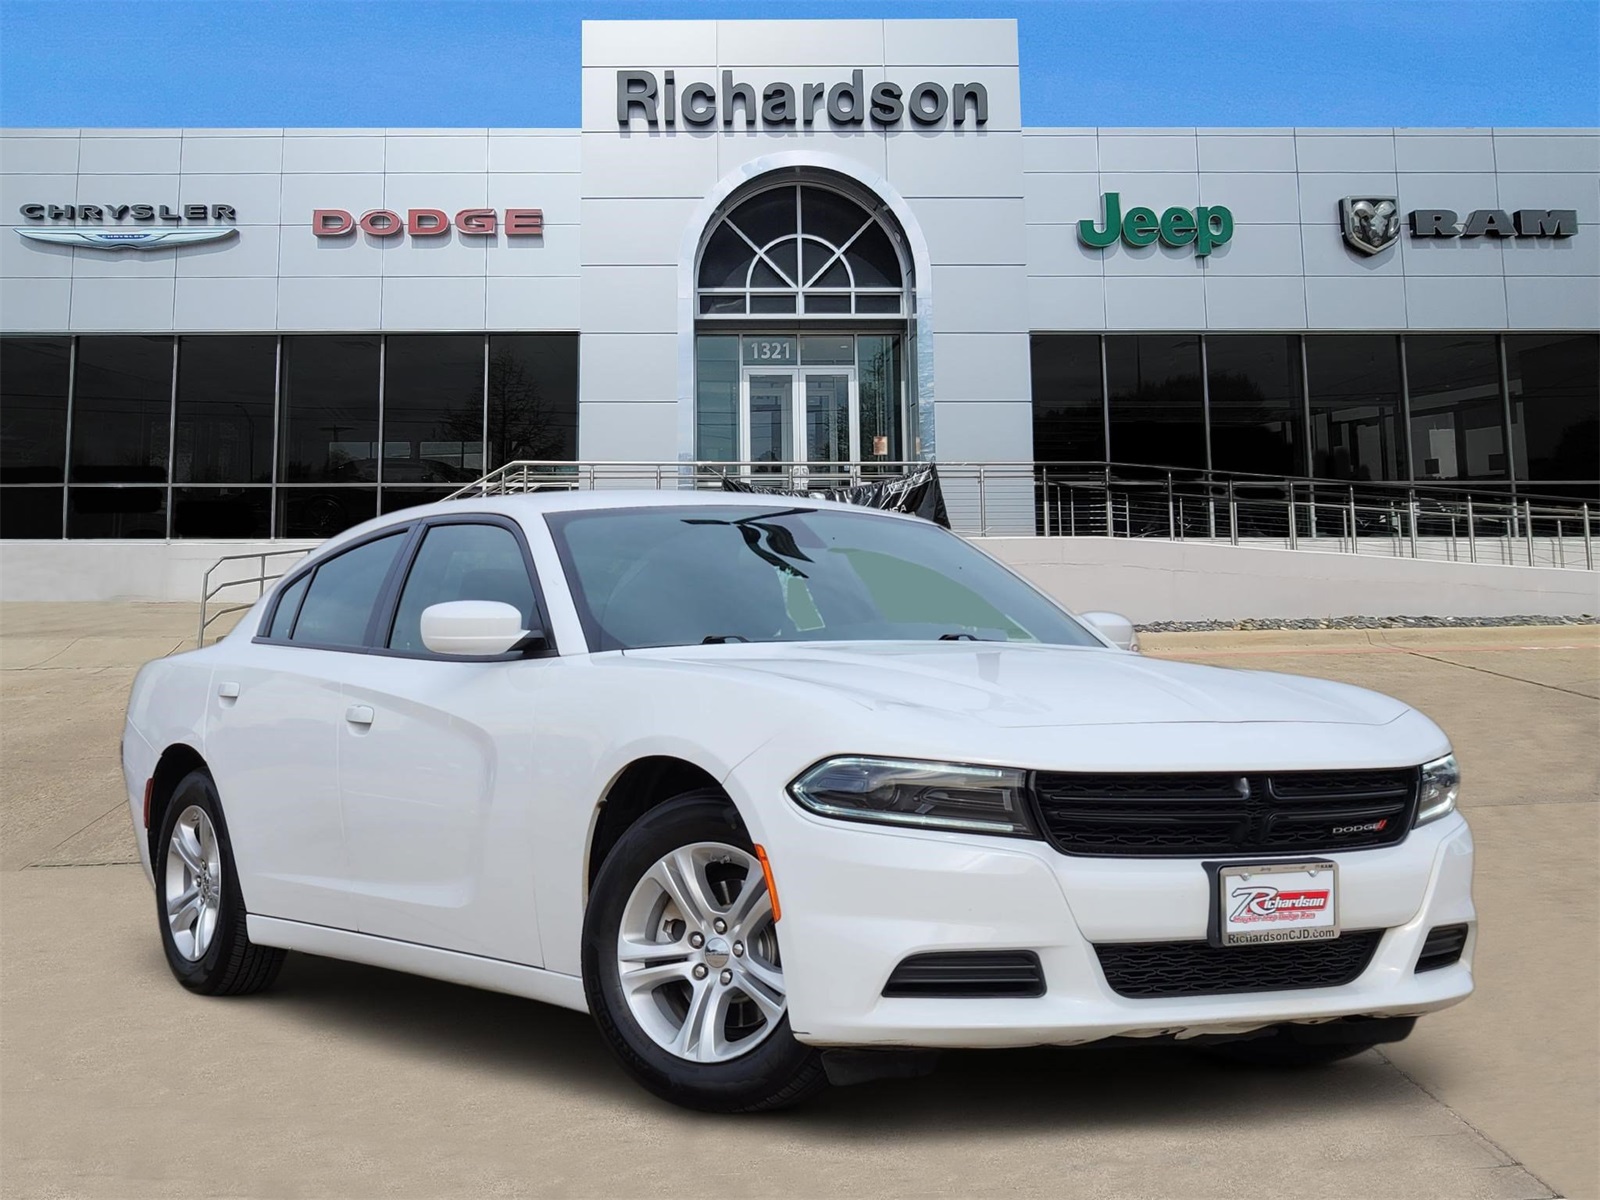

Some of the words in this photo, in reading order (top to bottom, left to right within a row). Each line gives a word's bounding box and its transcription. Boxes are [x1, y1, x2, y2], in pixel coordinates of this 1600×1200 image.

[616, 69, 988, 126] Richardson
[19, 203, 236, 221] CHRYSLER
[312, 208, 543, 237] DODGE
[1076, 192, 1234, 257] Jeep
[1408, 209, 1579, 238] RAM
[751, 342, 790, 359] 1321
[1332, 823, 1379, 834] DODGE
[1229, 886, 1325, 922] Richardson
[1228, 929, 1335, 944] RichardsonCJD.com
